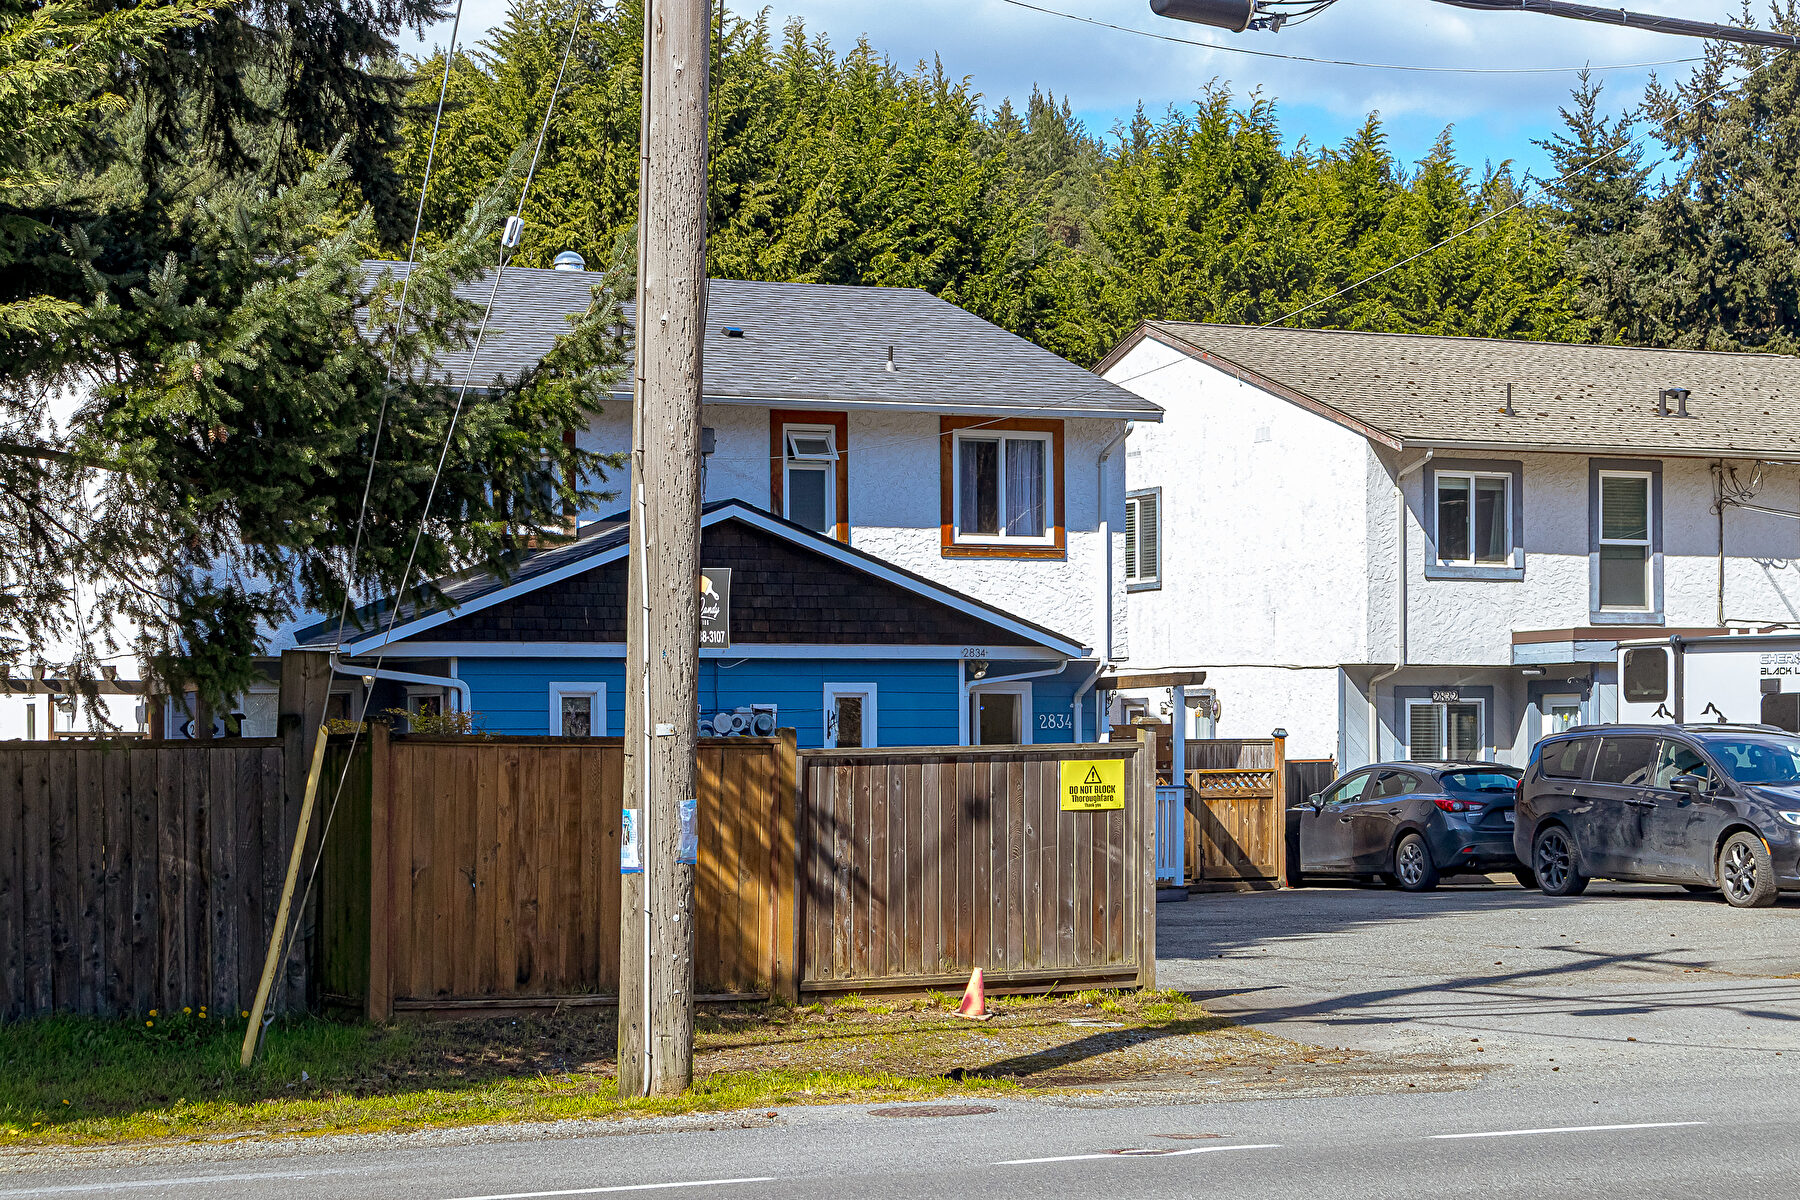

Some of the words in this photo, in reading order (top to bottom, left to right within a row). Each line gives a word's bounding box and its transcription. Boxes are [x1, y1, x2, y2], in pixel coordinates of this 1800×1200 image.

[963, 648, 986, 658] 2834
[1760, 667, 1792, 675] BLACK
[1432, 690, 1458, 702] 2832
[1039, 714, 1072, 729] 2834
[1069, 786, 1078, 794] DO
[1080, 786, 1092, 794] NOT
[1095, 785, 1115, 793] BLOCK
[1072, 794, 1114, 803] Thoroughfare
